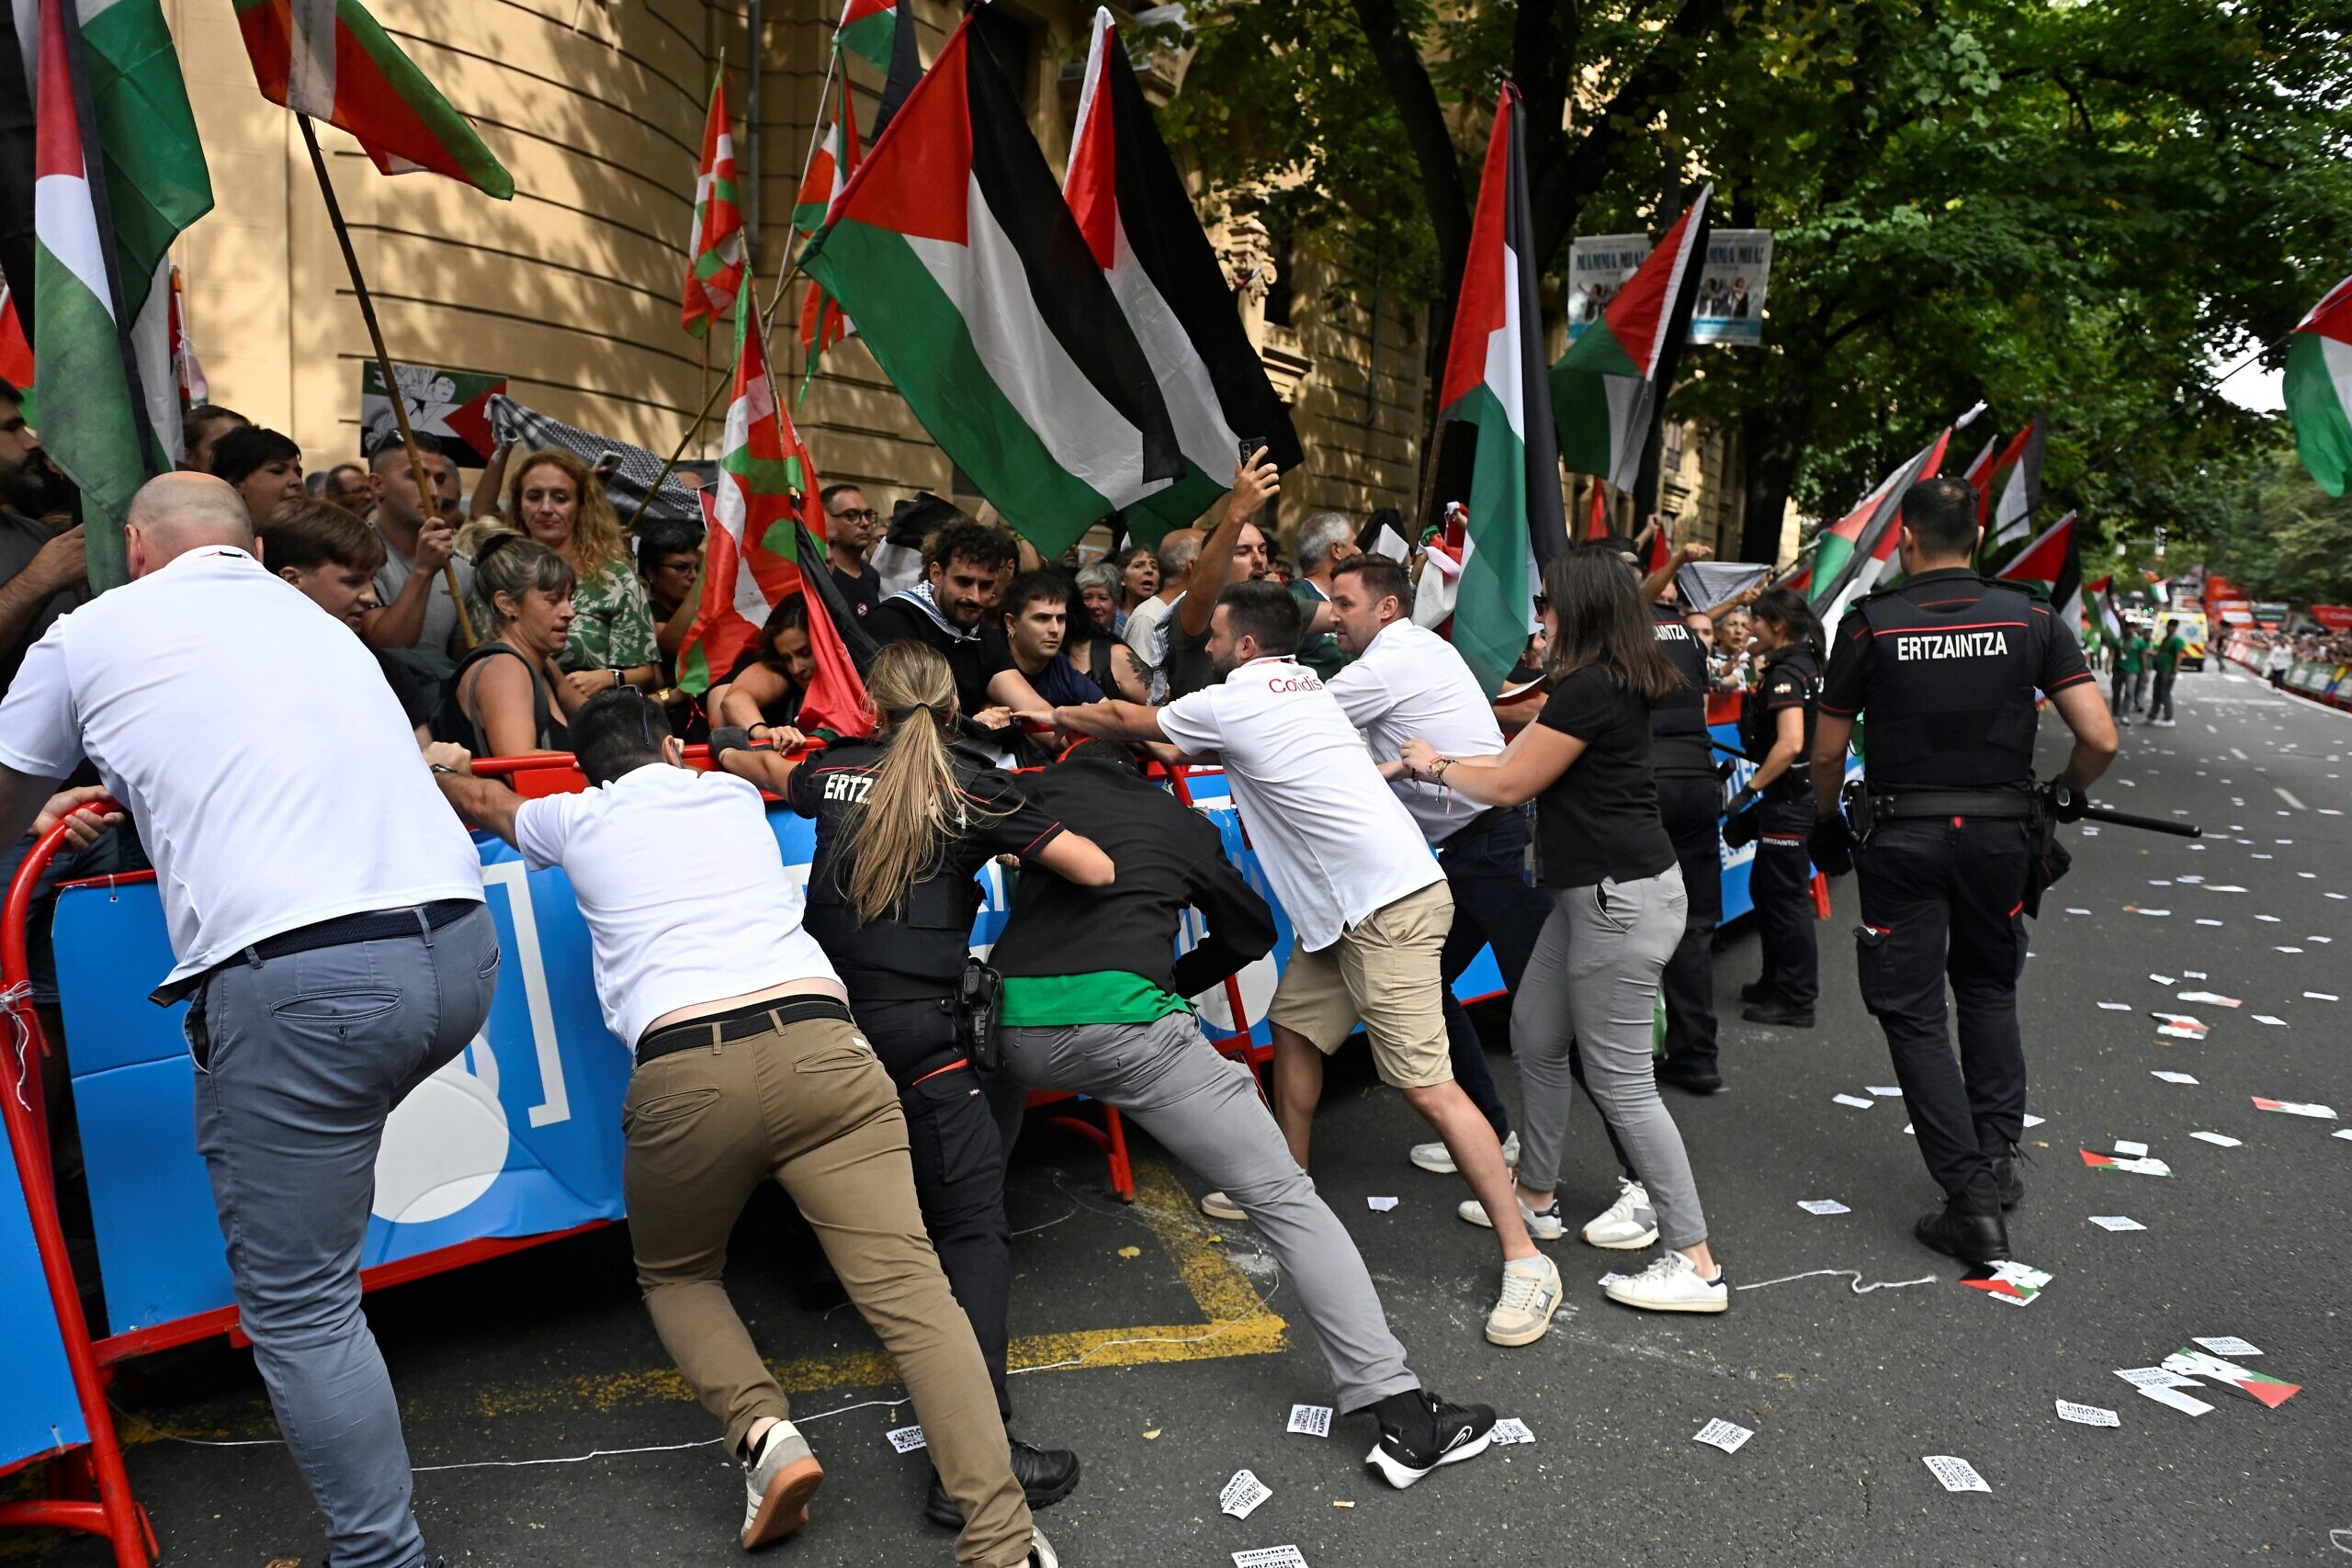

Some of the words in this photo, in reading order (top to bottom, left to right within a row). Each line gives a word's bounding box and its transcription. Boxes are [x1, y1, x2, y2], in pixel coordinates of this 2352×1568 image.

[1654, 624, 1690, 640] AINTZA
[1897, 631, 2007, 660] ERTZAINTZA
[1228, 1481, 1260, 1511] GENOZIDA
[1239, 1491, 1262, 1508] ISRAEL
[1238, 1548, 1295, 1560] KANPORA!
